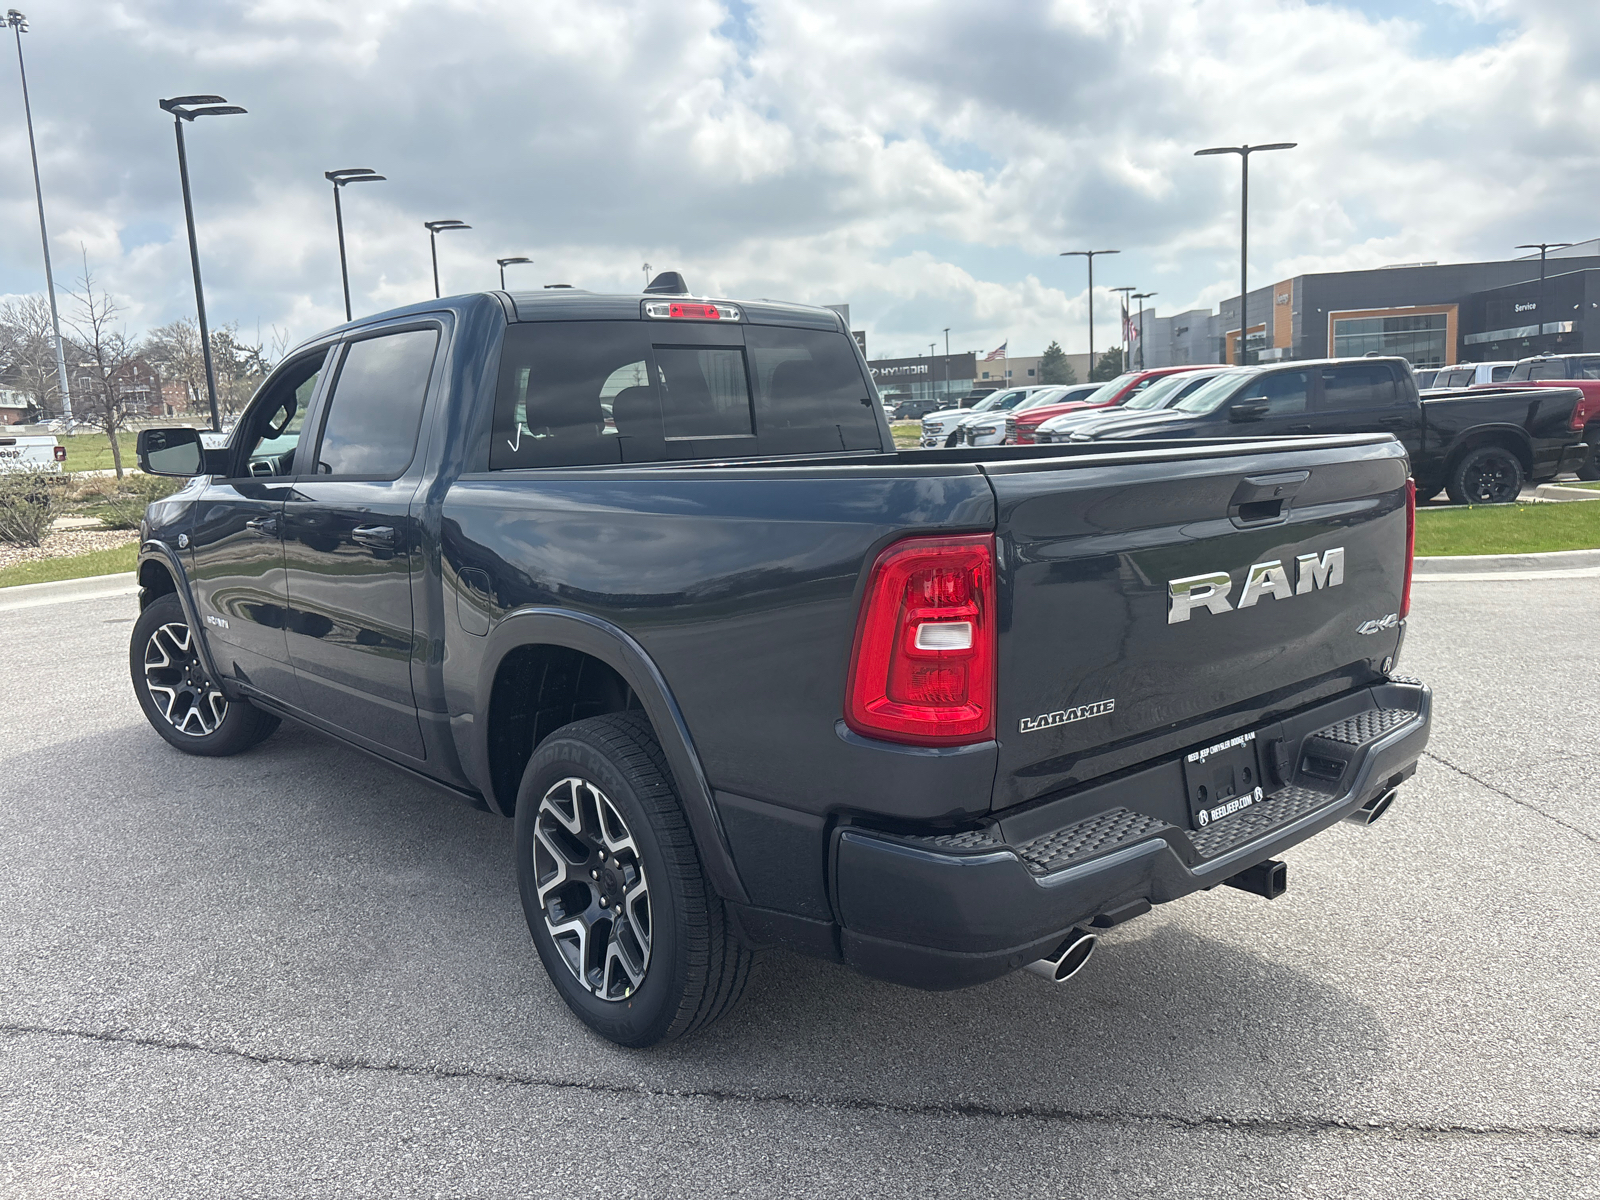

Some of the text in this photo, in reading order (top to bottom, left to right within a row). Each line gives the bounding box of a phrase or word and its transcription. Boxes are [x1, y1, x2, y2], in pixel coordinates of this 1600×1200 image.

[1514, 302, 1537, 313] Service
[881, 364, 928, 377] HYUNDAI
[0, 450, 20, 459] eep
[1167, 547, 1345, 625] RAM
[1019, 699, 1115, 733] LARAMIE
[1187, 731, 1256, 763] REED JEEP CHRYSLER DODGE RAM
[1210, 795, 1253, 821] REEDJEEP.COM
